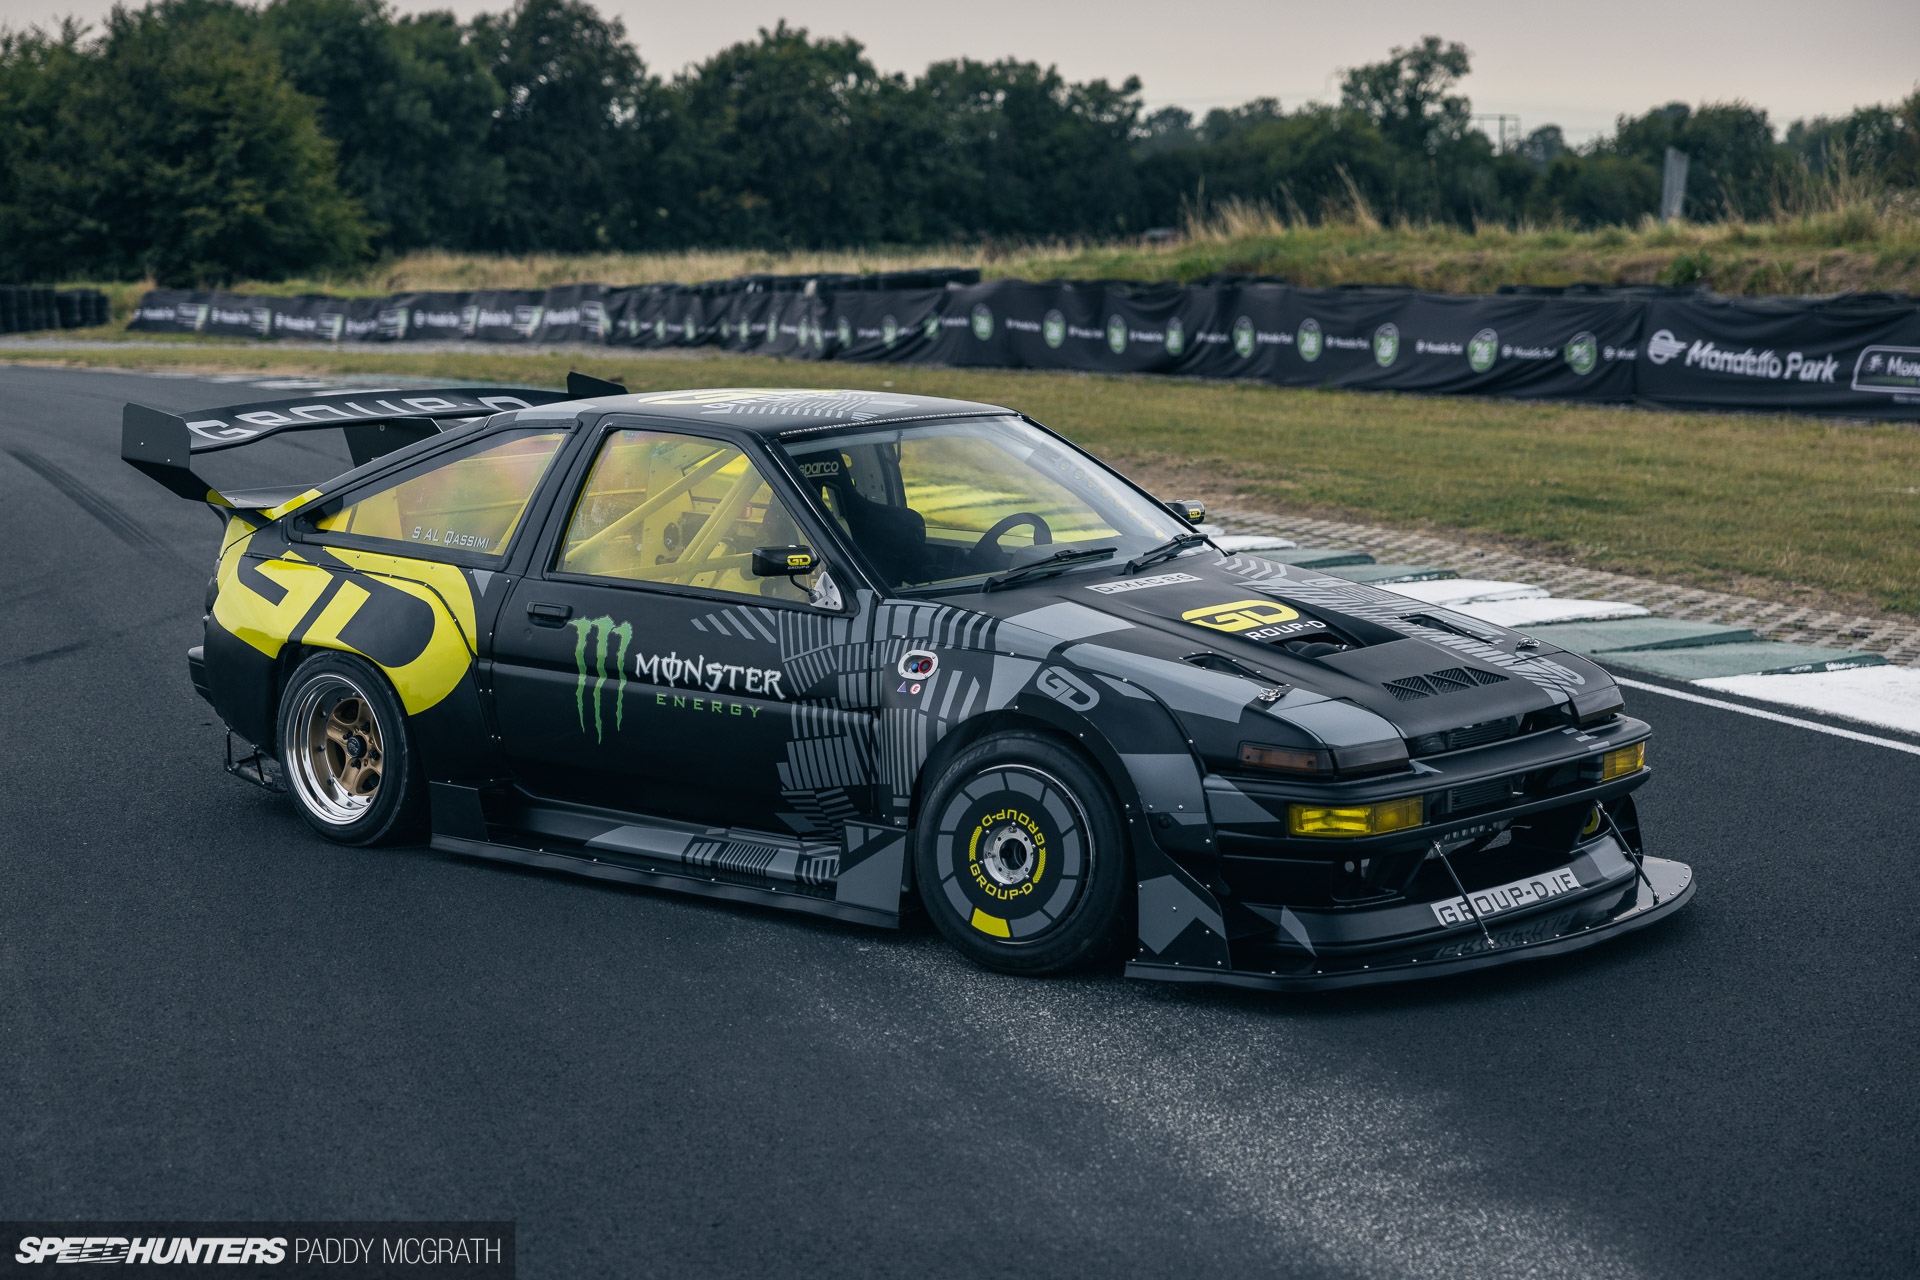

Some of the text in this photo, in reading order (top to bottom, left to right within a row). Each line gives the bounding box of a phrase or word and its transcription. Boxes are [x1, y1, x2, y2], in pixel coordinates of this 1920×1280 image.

[1685, 340, 1839, 383] Mondello Park
[412, 526, 422, 539] S
[423, 528, 439, 542] AL
[787, 554, 811, 566] GD
[656, 692, 763, 718] ENERGY
[981, 809, 1045, 846] GROUP-D
[969, 863, 1034, 900] GROUP-D
